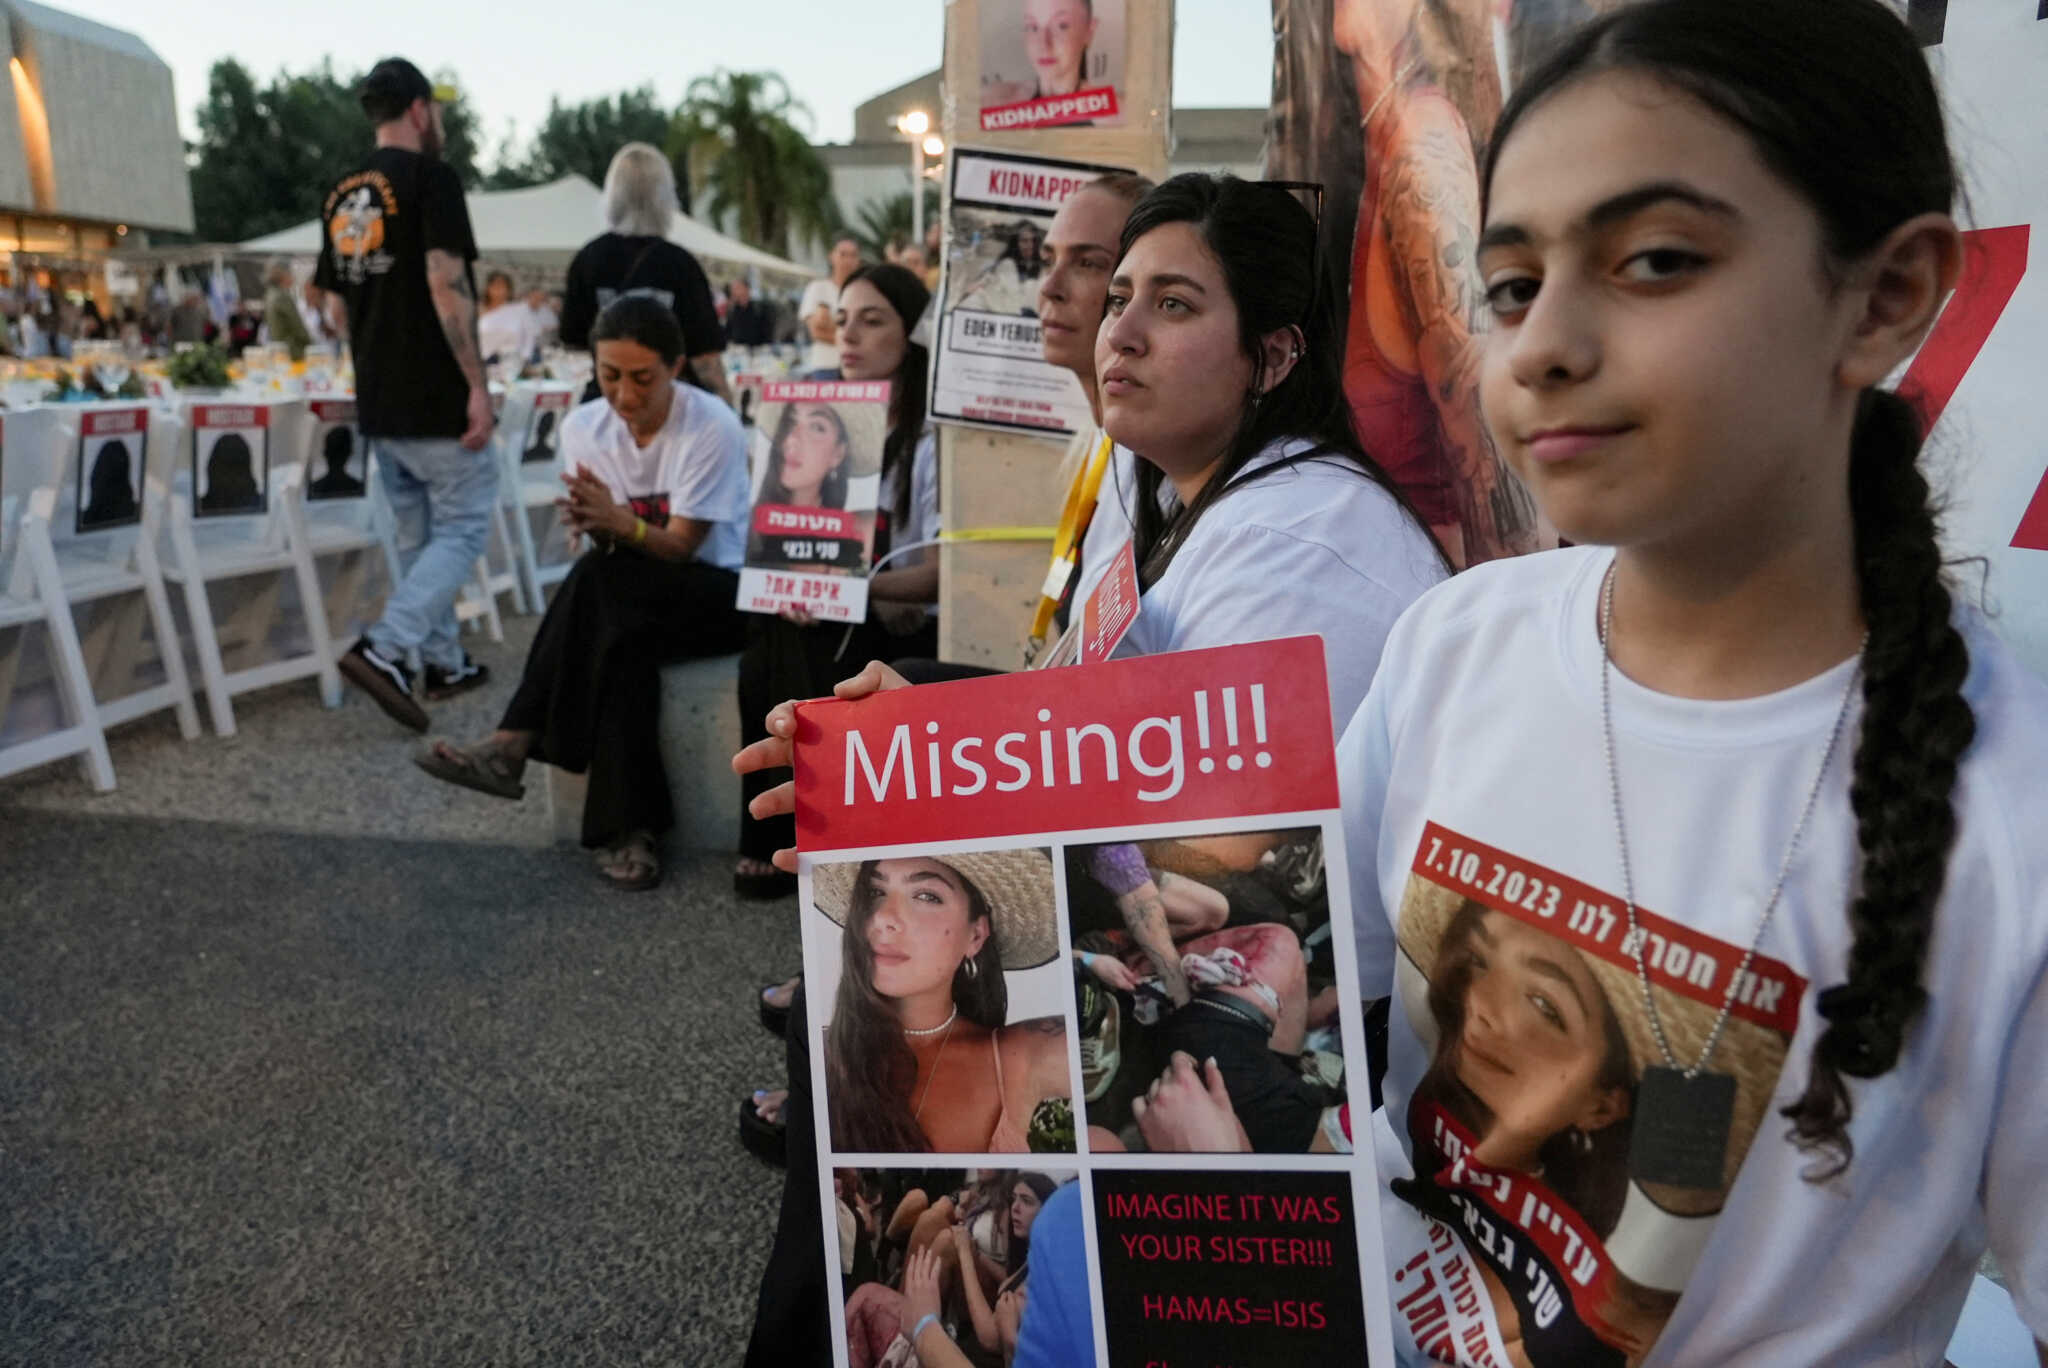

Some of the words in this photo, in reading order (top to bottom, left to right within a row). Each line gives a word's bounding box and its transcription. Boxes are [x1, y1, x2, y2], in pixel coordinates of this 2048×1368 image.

[983, 95, 1109, 129] KIDNAPPED!
[964, 318, 996, 337] EDEN
[768, 511, 842, 532] חטופה
[802, 579, 840, 600] איפה
[843, 684, 1272, 806] Missing!!!
[1424, 837, 1563, 919] 7.10.2023
[1568, 899, 1617, 943] לנו
[1107, 1193, 1232, 1221] IMAGINE
[1241, 1195, 1264, 1221] IT
[1271, 1196, 1341, 1223] WAS
[1121, 1234, 1202, 1261] YOUR
[1210, 1236, 1333, 1266] SISTER!!!
[1450, 1194, 1515, 1271] גבאי
[1520, 1192, 1598, 1286] עדיין
[1441, 1254, 1481, 1317] יכולה
[1526, 1258, 1563, 1328] שני
[1144, 1295, 1327, 1328] HAMAS=ISIS
